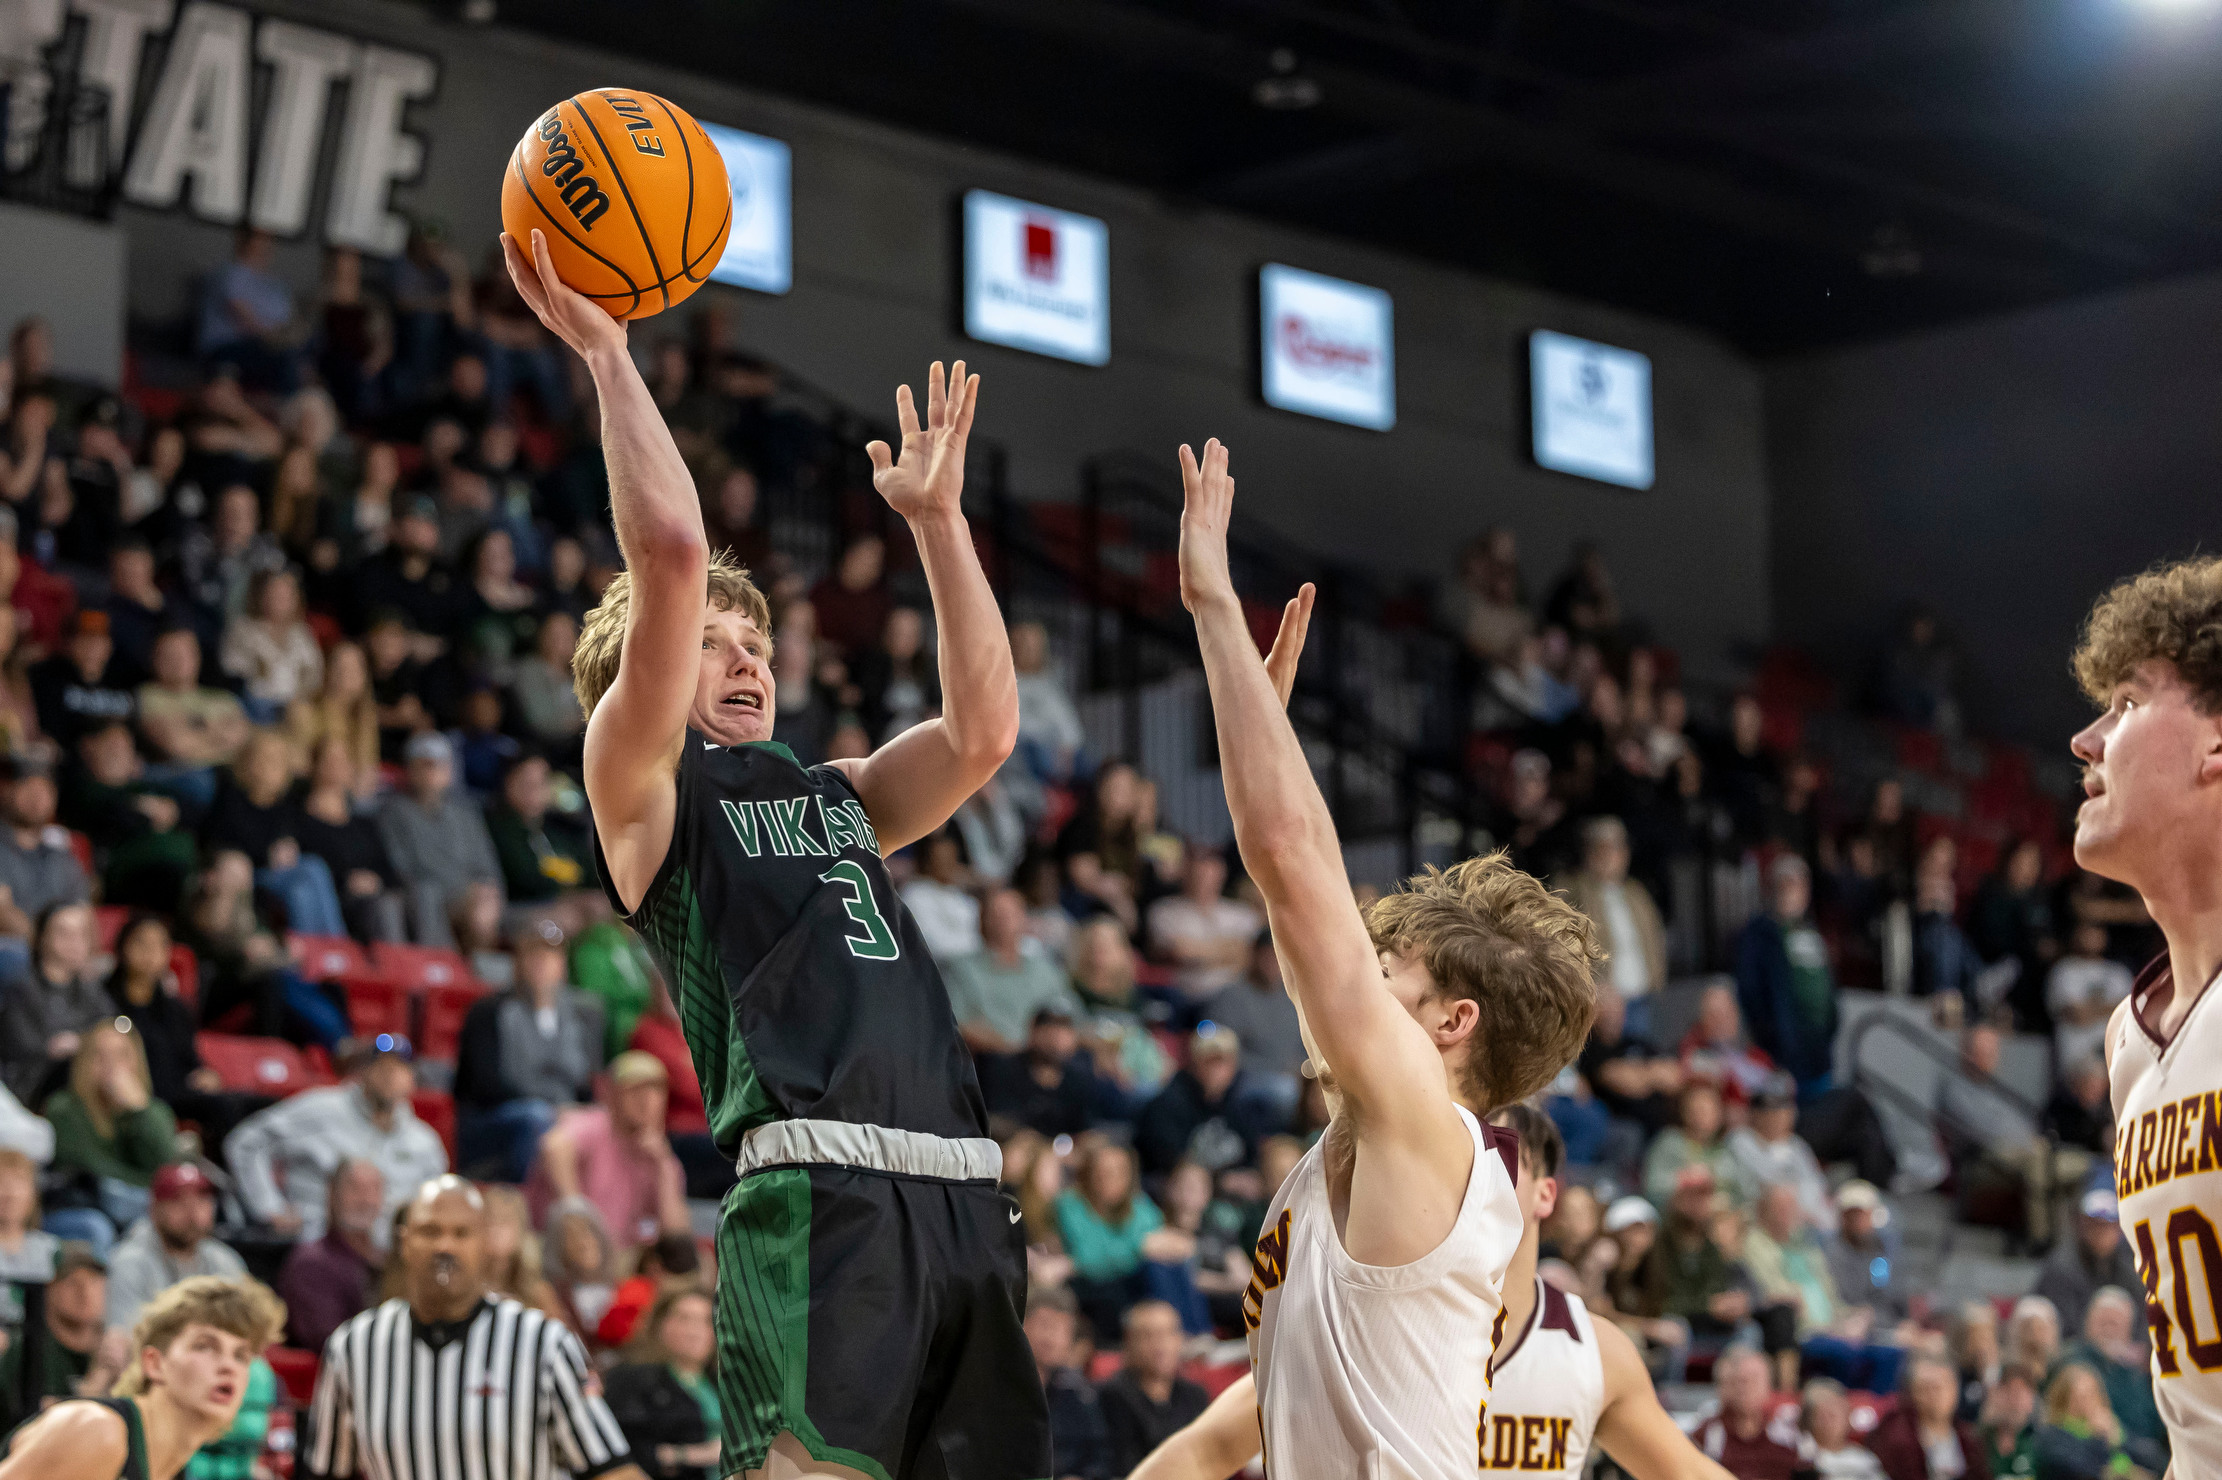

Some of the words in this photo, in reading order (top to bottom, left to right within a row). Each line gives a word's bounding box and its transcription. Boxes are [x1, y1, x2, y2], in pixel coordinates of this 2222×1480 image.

[537, 105, 610, 233] Wilson
[604, 96, 666, 158] EVO
[719, 794, 882, 859] VIKING
[818, 859, 900, 961] 3
[2112, 1089, 2222, 1201] ARDEN
